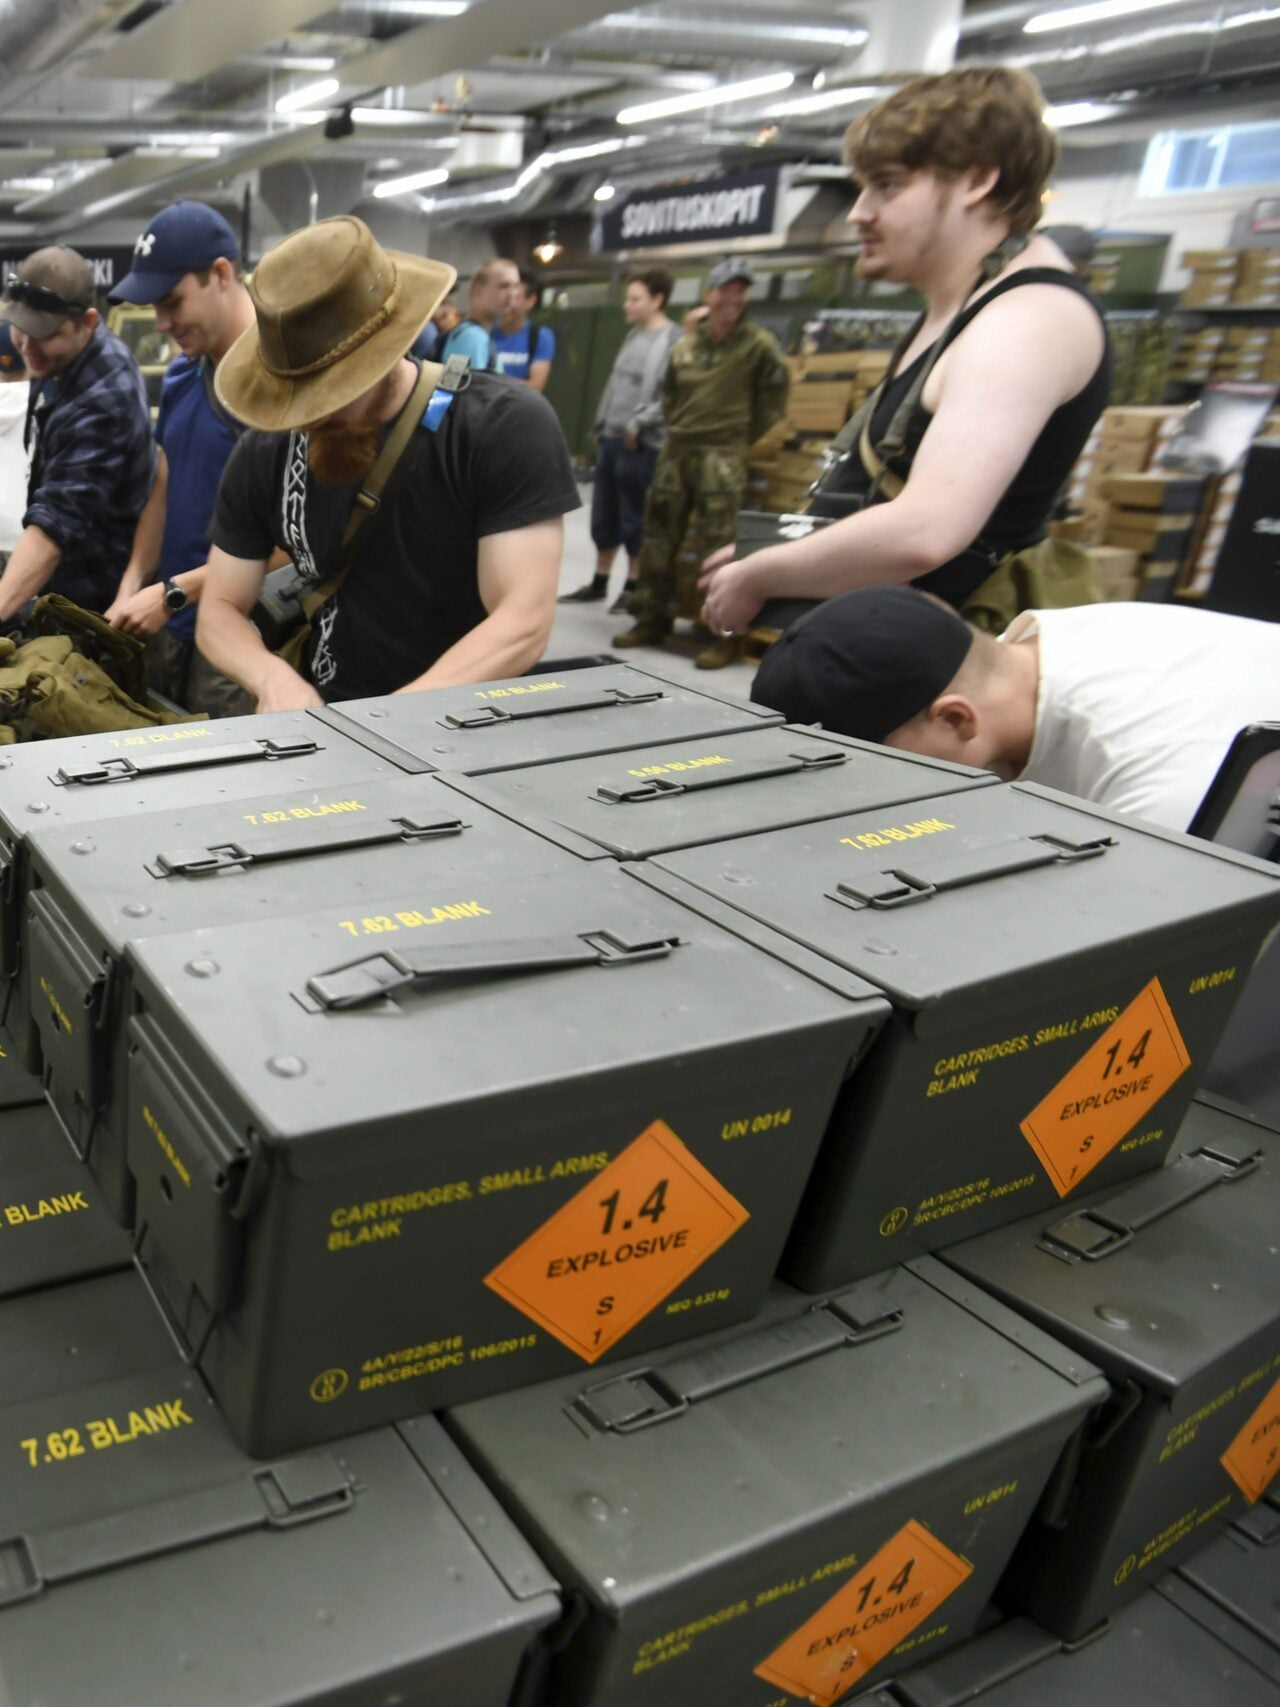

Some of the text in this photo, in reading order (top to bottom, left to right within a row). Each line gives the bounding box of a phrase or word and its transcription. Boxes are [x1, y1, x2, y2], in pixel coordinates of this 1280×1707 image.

[474, 681, 566, 699] 7.62 BLANK
[148, 728, 212, 743] BLANK
[664, 755, 733, 771] BLANK
[243, 800, 367, 825] 7.62 BLANK
[839, 818, 956, 850] 7.62 BLANK
[338, 900, 492, 936] 7.62 BLANK
[1189, 975, 1209, 995] UN
[1033, 1019, 1077, 1046] SMALL
[1102, 1028, 1152, 1081] 1.4
[926, 1068, 980, 1099] BLANK
[1059, 1074, 1154, 1122] EXPLOSIVE
[722, 1107, 792, 1140] UN 0014
[1079, 1135, 1094, 1153] S
[4, 1191, 89, 1226] BLANK
[330, 1180, 473, 1228] CARTRIDGES,
[479, 1164, 546, 1195] SMALL
[599, 1178, 669, 1235] 1.4
[327, 1218, 403, 1251] BLANK
[546, 1229, 690, 1279] EXPLOSIVE
[596, 1296, 615, 1316] S
[593, 1328, 602, 1345] 1
[20, 1397, 194, 1468] 7.62 BLANK
[754, 1575, 808, 1607] SMALL
[856, 1557, 917, 1614] 1.4
[807, 1590, 925, 1657] EXPLOSIVE
[632, 1639, 693, 1676] BLANK
